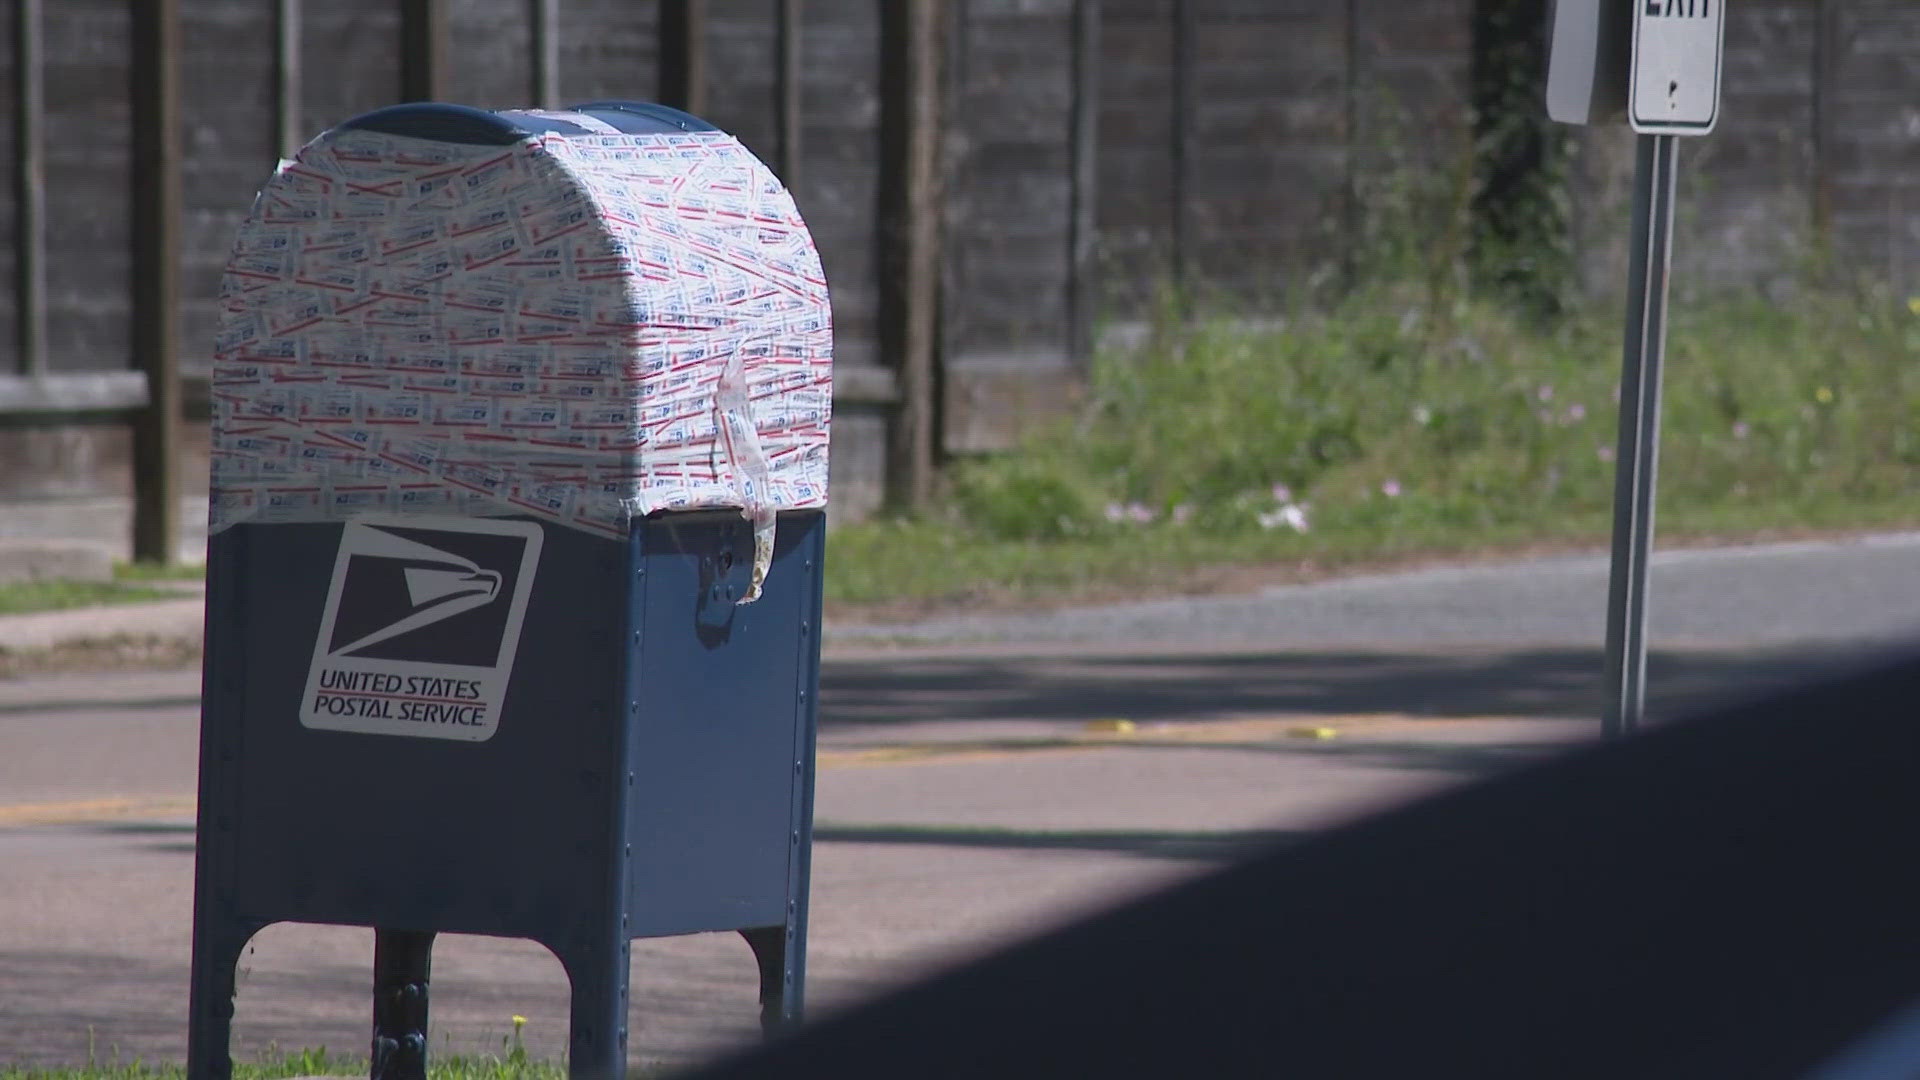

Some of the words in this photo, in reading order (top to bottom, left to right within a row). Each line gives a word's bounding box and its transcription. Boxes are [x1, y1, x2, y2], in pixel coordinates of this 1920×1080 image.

[320, 669, 402, 693] UNITED
[404, 676, 481, 700] STATES
[313, 696, 393, 720] POSTAL
